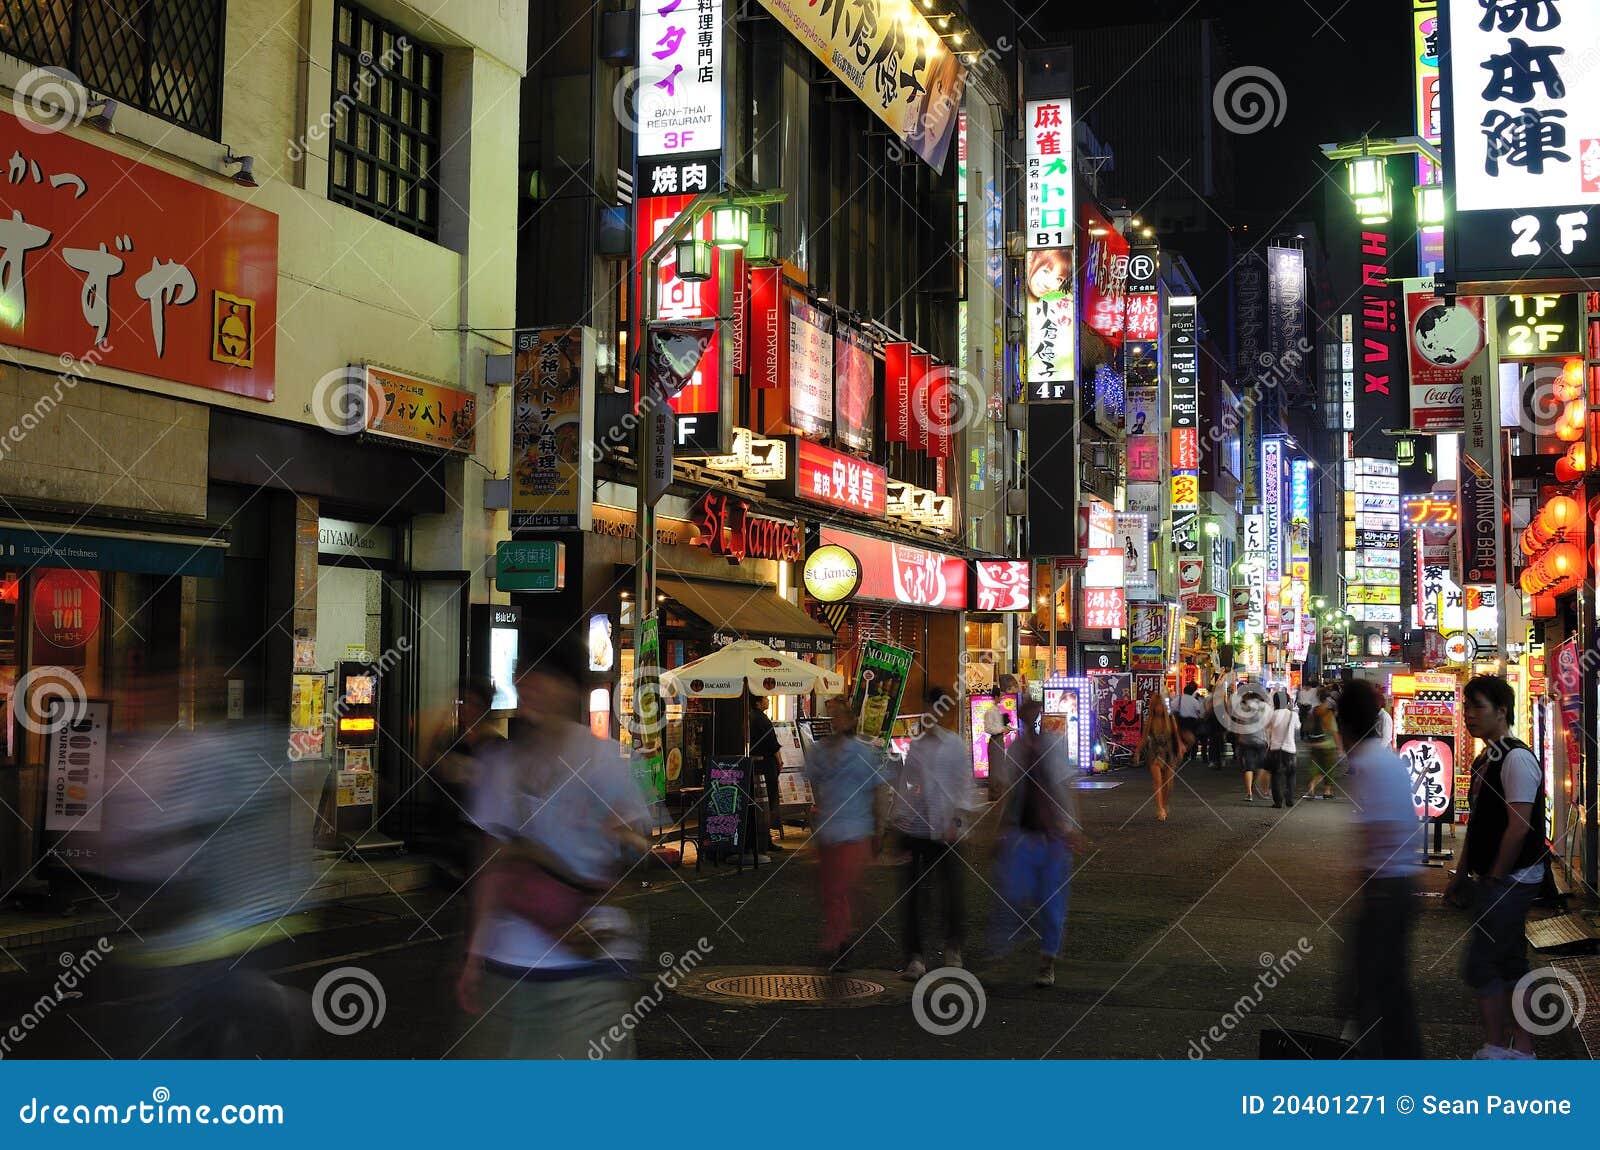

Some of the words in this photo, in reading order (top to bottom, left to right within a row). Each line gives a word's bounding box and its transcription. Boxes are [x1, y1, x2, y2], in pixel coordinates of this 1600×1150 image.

[647, 115, 713, 128] RESTAURANT
[654, 105, 706, 118] BAN-THAI
[664, 131, 695, 149] 3F
[1034, 104, 1062, 155] 麻雀
[652, 163, 707, 194] 焼肉
[1037, 232, 1063, 245] B1
[1511, 211, 1589, 257] 2F
[519, 335, 539, 349] 5F
[733, 290, 744, 370] ANRAKUTEI
[1508, 324, 1564, 354] 2F
[766, 308, 778, 385] ANRAKUTEI
[538, 343, 559, 469] 本格ベトナム料理
[899, 376, 907, 438] ANRAKUTEI
[1036, 383, 1066, 399] 4F
[919, 387, 928, 447] ANRAKUTEI
[1471, 375, 1484, 449] 劇場通り一番街
[813, 469, 831, 497] 焼肉
[1476, 477, 1493, 533] DINING
[32, 546, 53, 556] quality
[67, 548, 98, 558] freshness
[502, 548, 551, 564] 大塚歯科
[1478, 537, 1495, 569] BAR
[57, 719, 69, 772] GOURMET
[55, 776, 66, 817] COFFEE
